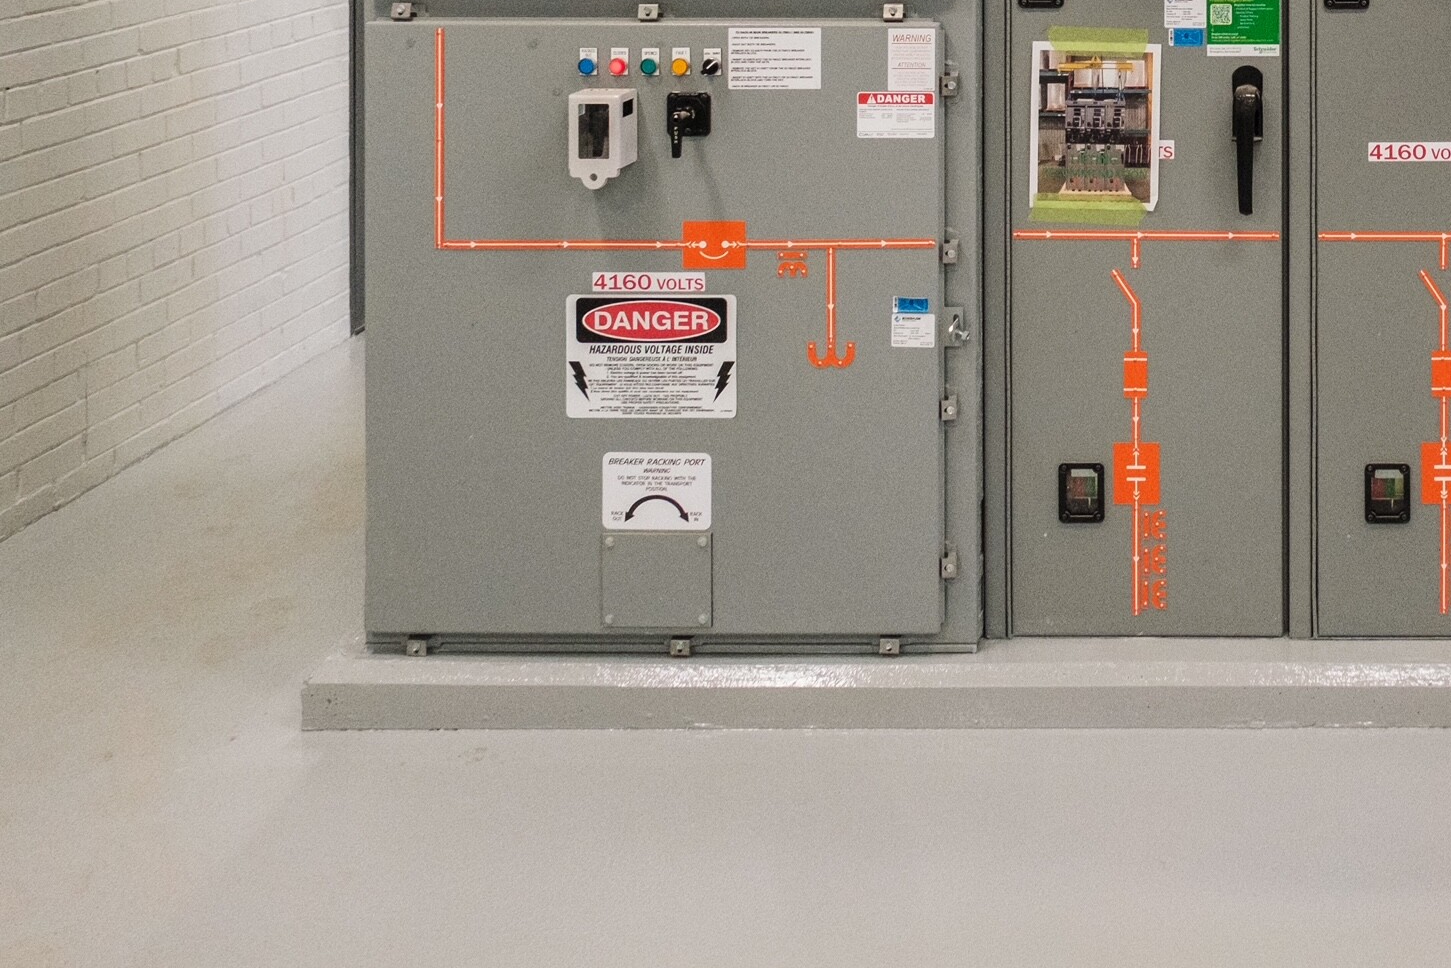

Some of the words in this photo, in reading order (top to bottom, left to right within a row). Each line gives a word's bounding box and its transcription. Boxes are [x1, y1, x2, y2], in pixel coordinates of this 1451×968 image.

[892, 34, 932, 43] WARNING
[876, 94, 926, 104] DANGER
[1369, 144, 1427, 160] 4160
[594, 274, 652, 291] 4160
[658, 278, 704, 292] VOLTS
[594, 310, 709, 332] DANGER
[589, 344, 642, 354] HAZARDOUS
[644, 344, 682, 354] VOLTAGE
[684, 344, 714, 354] INSIDE
[608, 458, 644, 466] BREAKER
[646, 458, 682, 466] RACKING
[684, 458, 706, 466] PORT
